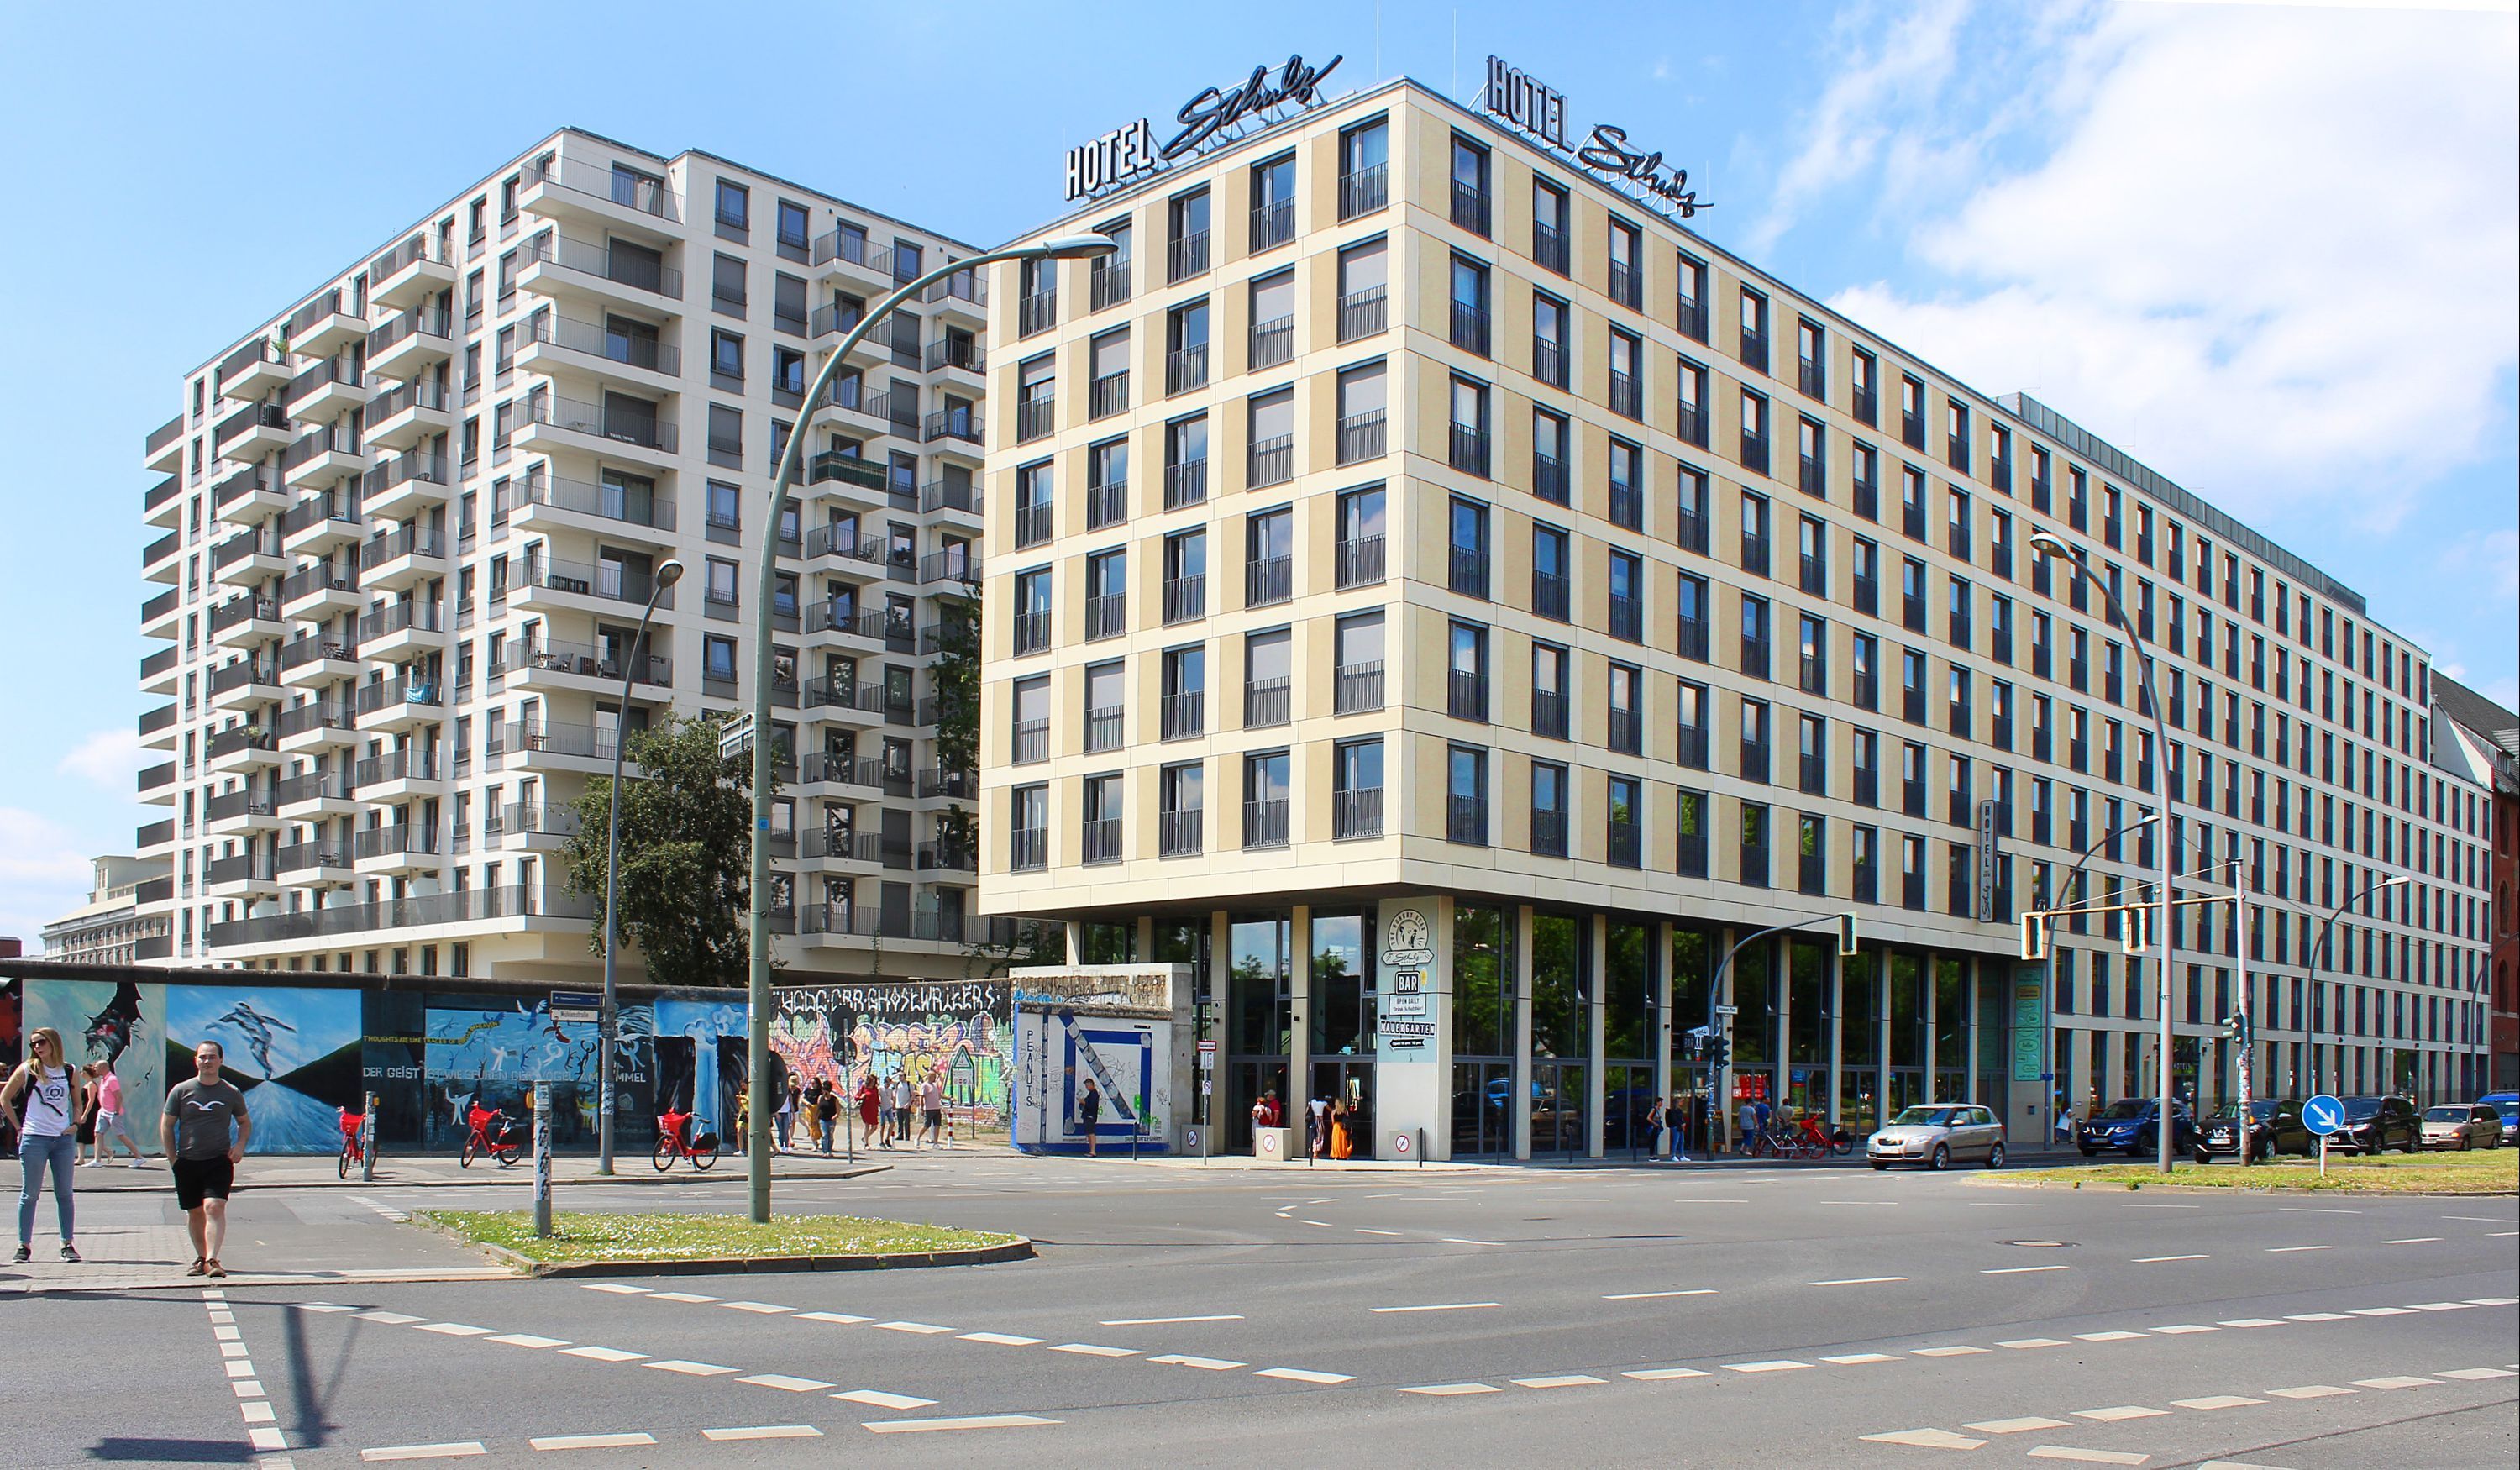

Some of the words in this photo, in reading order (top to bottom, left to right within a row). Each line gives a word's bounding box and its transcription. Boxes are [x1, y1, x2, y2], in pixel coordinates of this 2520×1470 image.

[1065, 118, 1155, 201] HOTEL
[1159, 54, 1343, 160] Schulz
[1487, 55, 1575, 154] HOTEL
[1578, 124, 1714, 218] Schulz
[1399, 975, 1417, 991] BAR
[1380, 1021, 1435, 1036] MAUERGARTEN
[363, 1067, 383, 1077] DER
